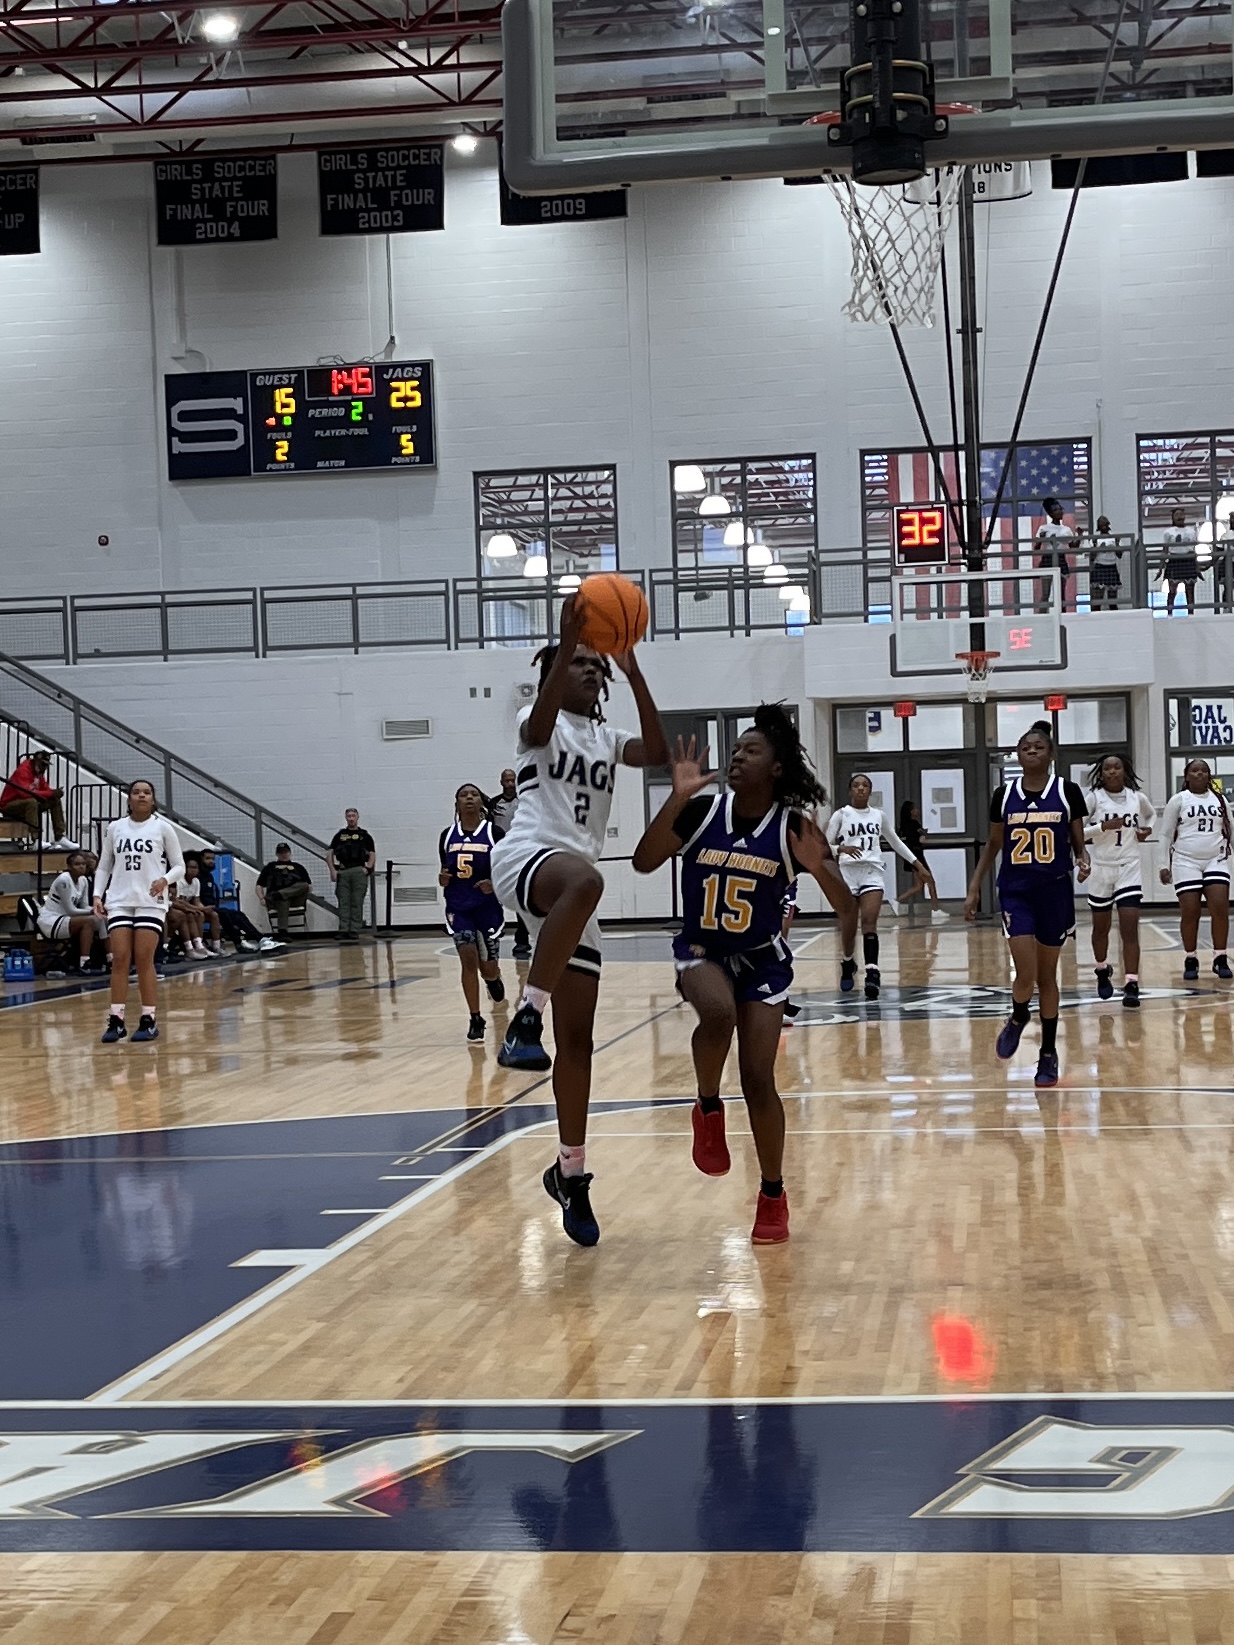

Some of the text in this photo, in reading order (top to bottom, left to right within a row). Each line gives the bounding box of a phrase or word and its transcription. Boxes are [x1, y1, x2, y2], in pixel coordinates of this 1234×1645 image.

[320, 148, 441, 171] GIRLS SOCCER
[156, 160, 275, 181] GIRLS SOCCER
[354, 170, 407, 189] STATE
[191, 181, 243, 199] STATE
[326, 189, 435, 210] FINAL FOUR
[165, 200, 269, 220] FINAL FOUR
[540, 198, 586, 217] 2009
[358, 210, 403, 228] 2003
[195, 221, 241, 239] 2004
[256, 374, 298, 386] GUEST
[331, 367, 373, 396] 1:45
[383, 366, 423, 379] JAGS
[273, 387, 297, 414] 15
[389, 380, 422, 409] 25
[307, 407, 346, 418] PERIOD
[350, 401, 364, 422] 2
[171, 397, 245, 454] S
[274, 440, 290, 462] 2
[399, 433, 415, 455] 5
[899, 511, 942, 546] 32
[574, 792, 591, 826] 2
[1187, 804, 1224, 818] JAGS
[847, 822, 880, 837] JAGS
[1197, 818, 1214, 832] 21
[116, 838, 153, 854] JAGS
[860, 836, 874, 851] 11
[1010, 827, 1055, 865] 20
[1115, 830, 1122, 846] 1
[124, 854, 142, 871] 25
[456, 853, 474, 879] 5
[700, 872, 758, 934] 15
